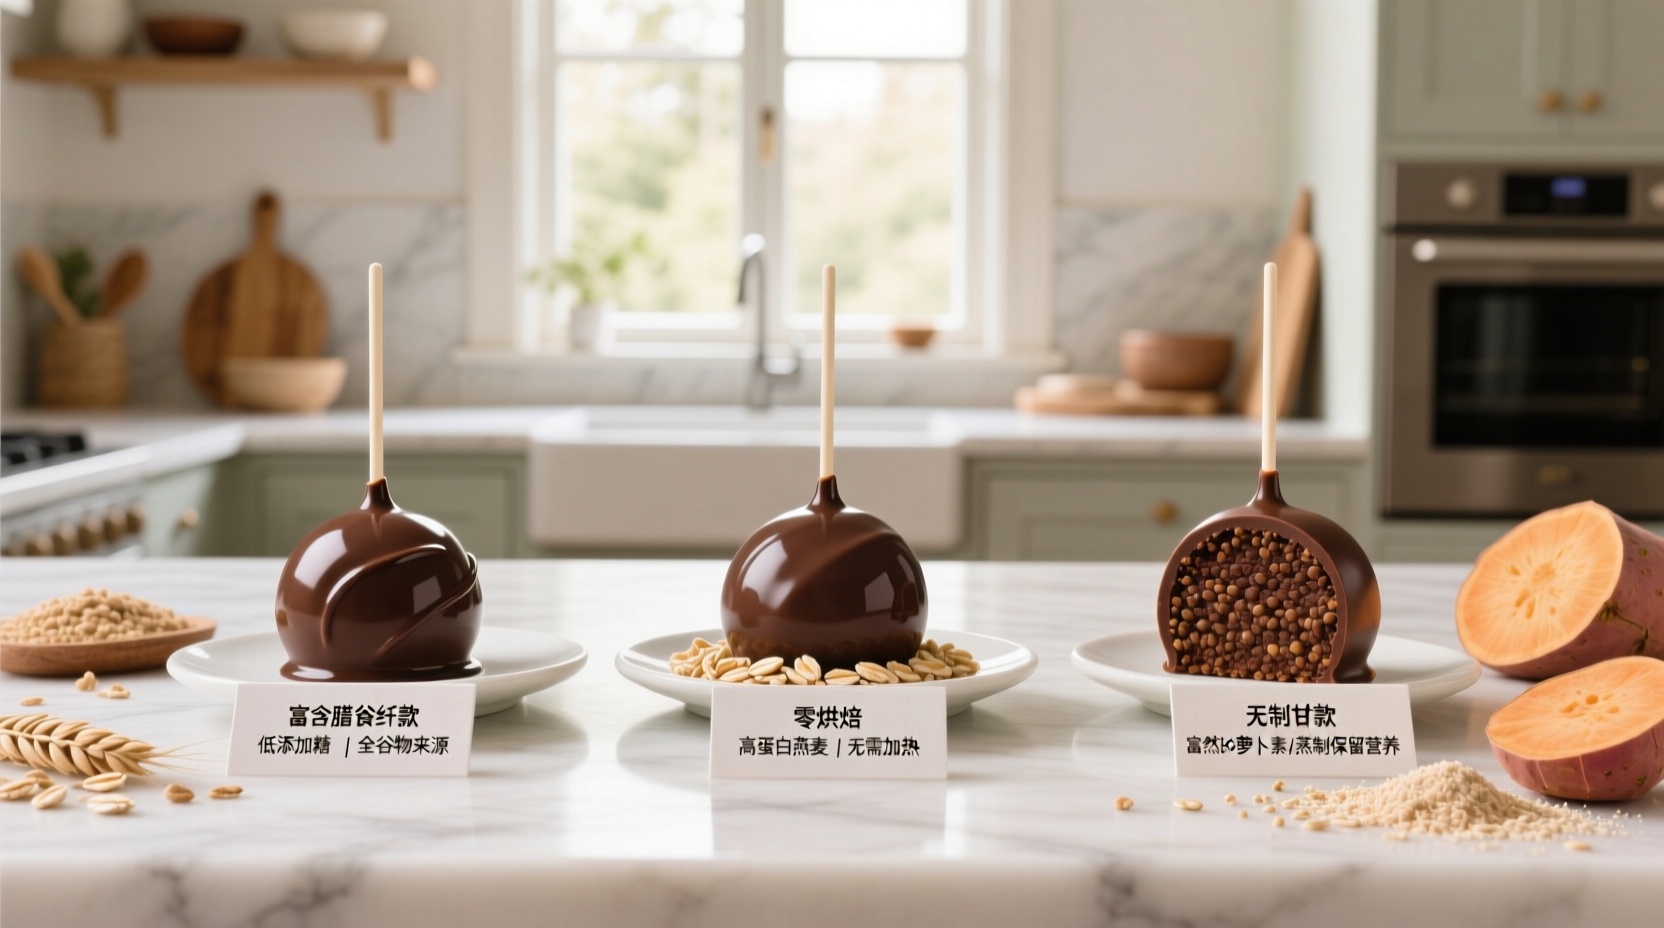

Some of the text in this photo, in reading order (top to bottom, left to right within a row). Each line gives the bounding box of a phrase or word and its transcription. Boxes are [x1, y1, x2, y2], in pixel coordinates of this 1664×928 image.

[793, 705, 863, 730] 零烘焙
[257, 734, 332, 755] 低添加糖
[357, 734, 450, 756] 全谷物来源
[738, 735, 829, 756] 高蛋白燕麦
[847, 735, 921, 757] 无需加热
